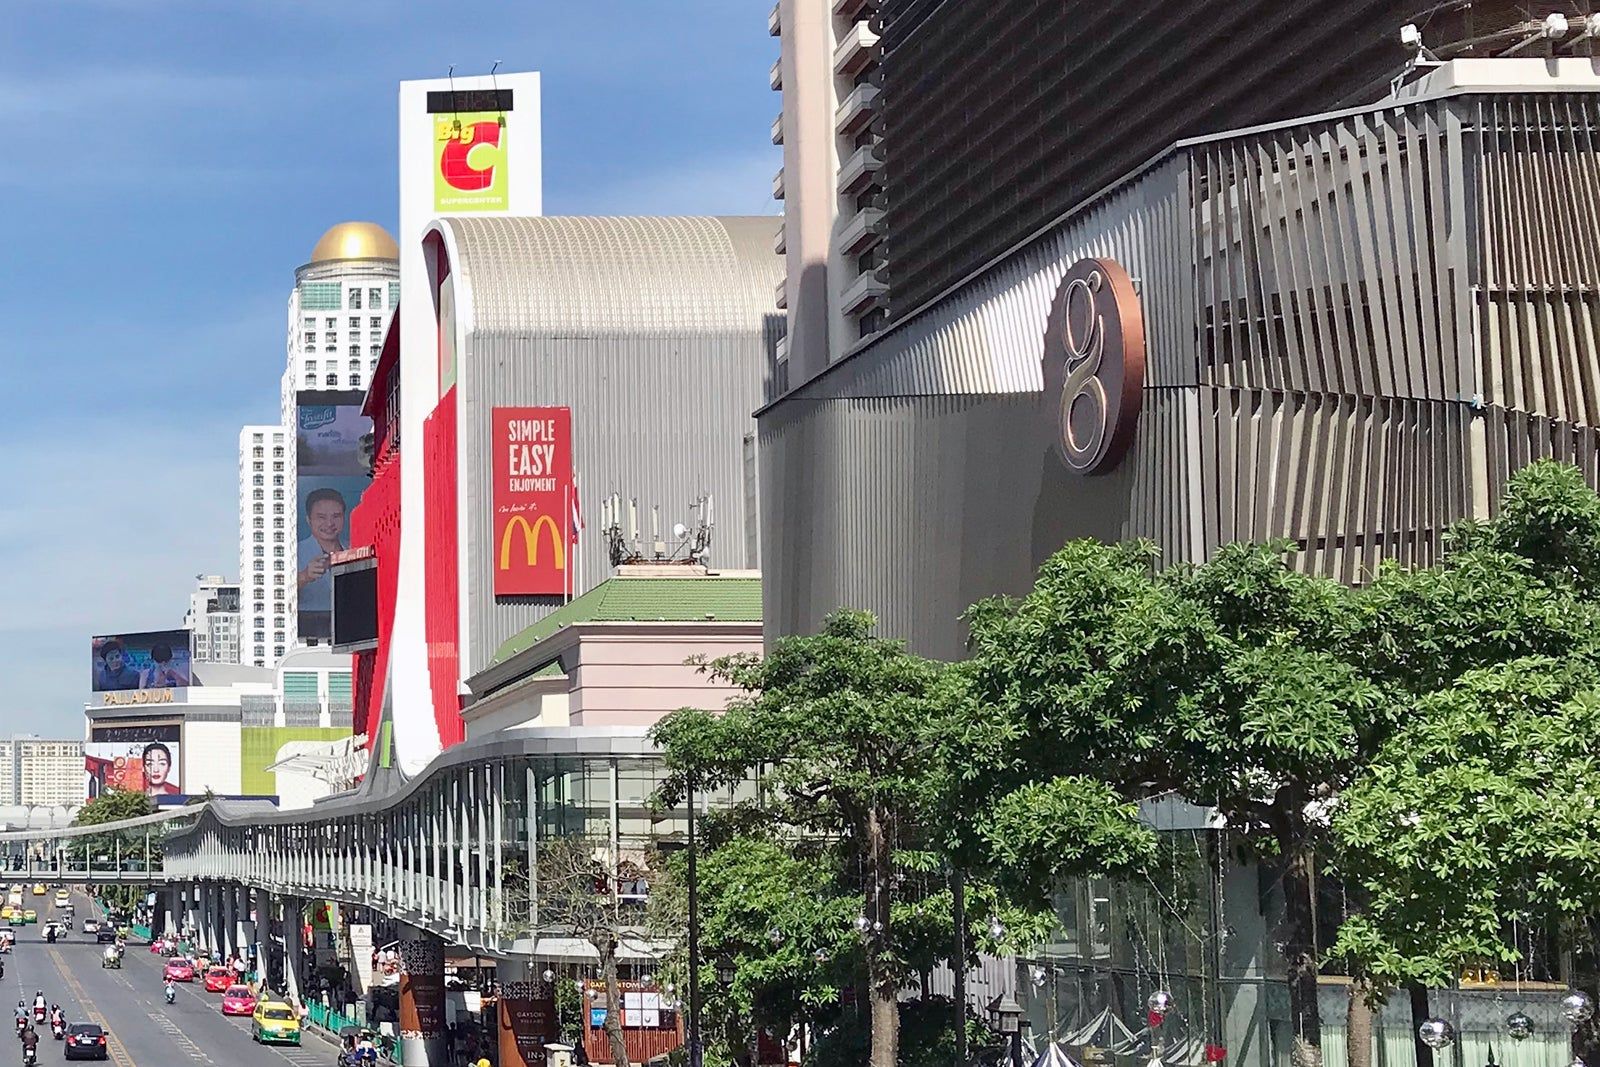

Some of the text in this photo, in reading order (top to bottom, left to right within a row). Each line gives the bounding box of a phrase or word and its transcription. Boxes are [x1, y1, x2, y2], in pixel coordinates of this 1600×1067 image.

[438, 122, 476, 145] Big
[508, 419, 555, 442] SIMPLE
[509, 444, 555, 476] EASY
[509, 477, 556, 492] ENJOYMENT
[103, 688, 174, 706] PALLADIUM
[527, 1051, 538, 1059] IN
